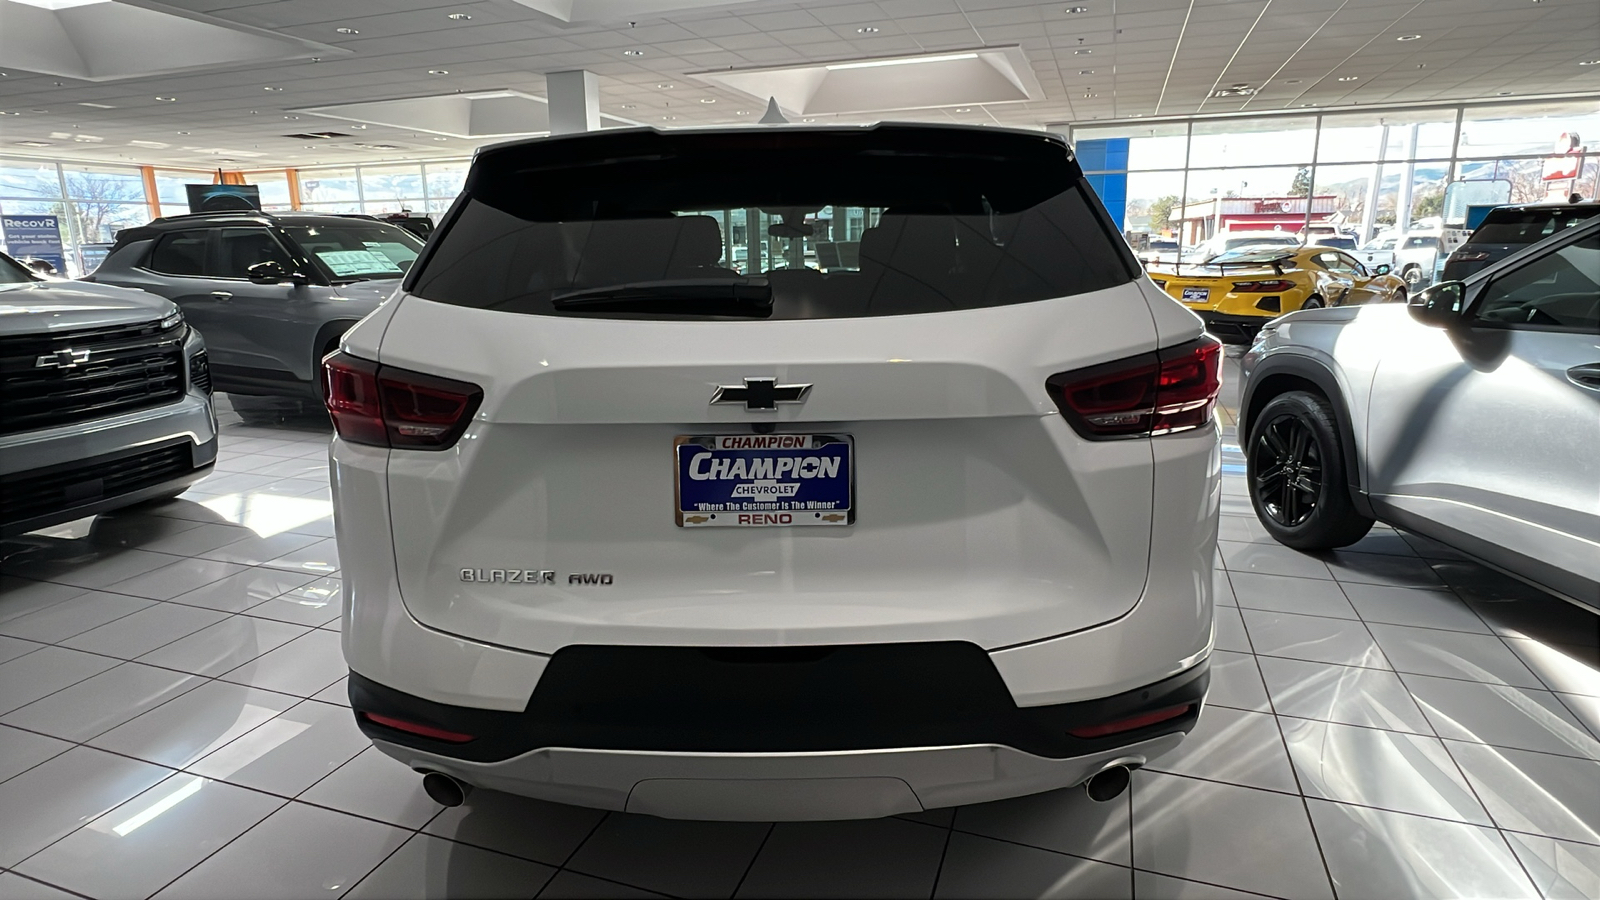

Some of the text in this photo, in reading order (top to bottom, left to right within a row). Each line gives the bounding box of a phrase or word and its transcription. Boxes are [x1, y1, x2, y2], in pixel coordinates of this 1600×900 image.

[4, 219, 56, 228] RecovR
[722, 437, 806, 449] CHAMPION
[688, 452, 841, 481] CHAMPION
[735, 485, 796, 495] CHEVROLET
[694, 500, 840, 511] "Where The Customer Is The Winner"
[738, 513, 792, 525] RENO
[460, 568, 614, 585] BLAZER AWD
